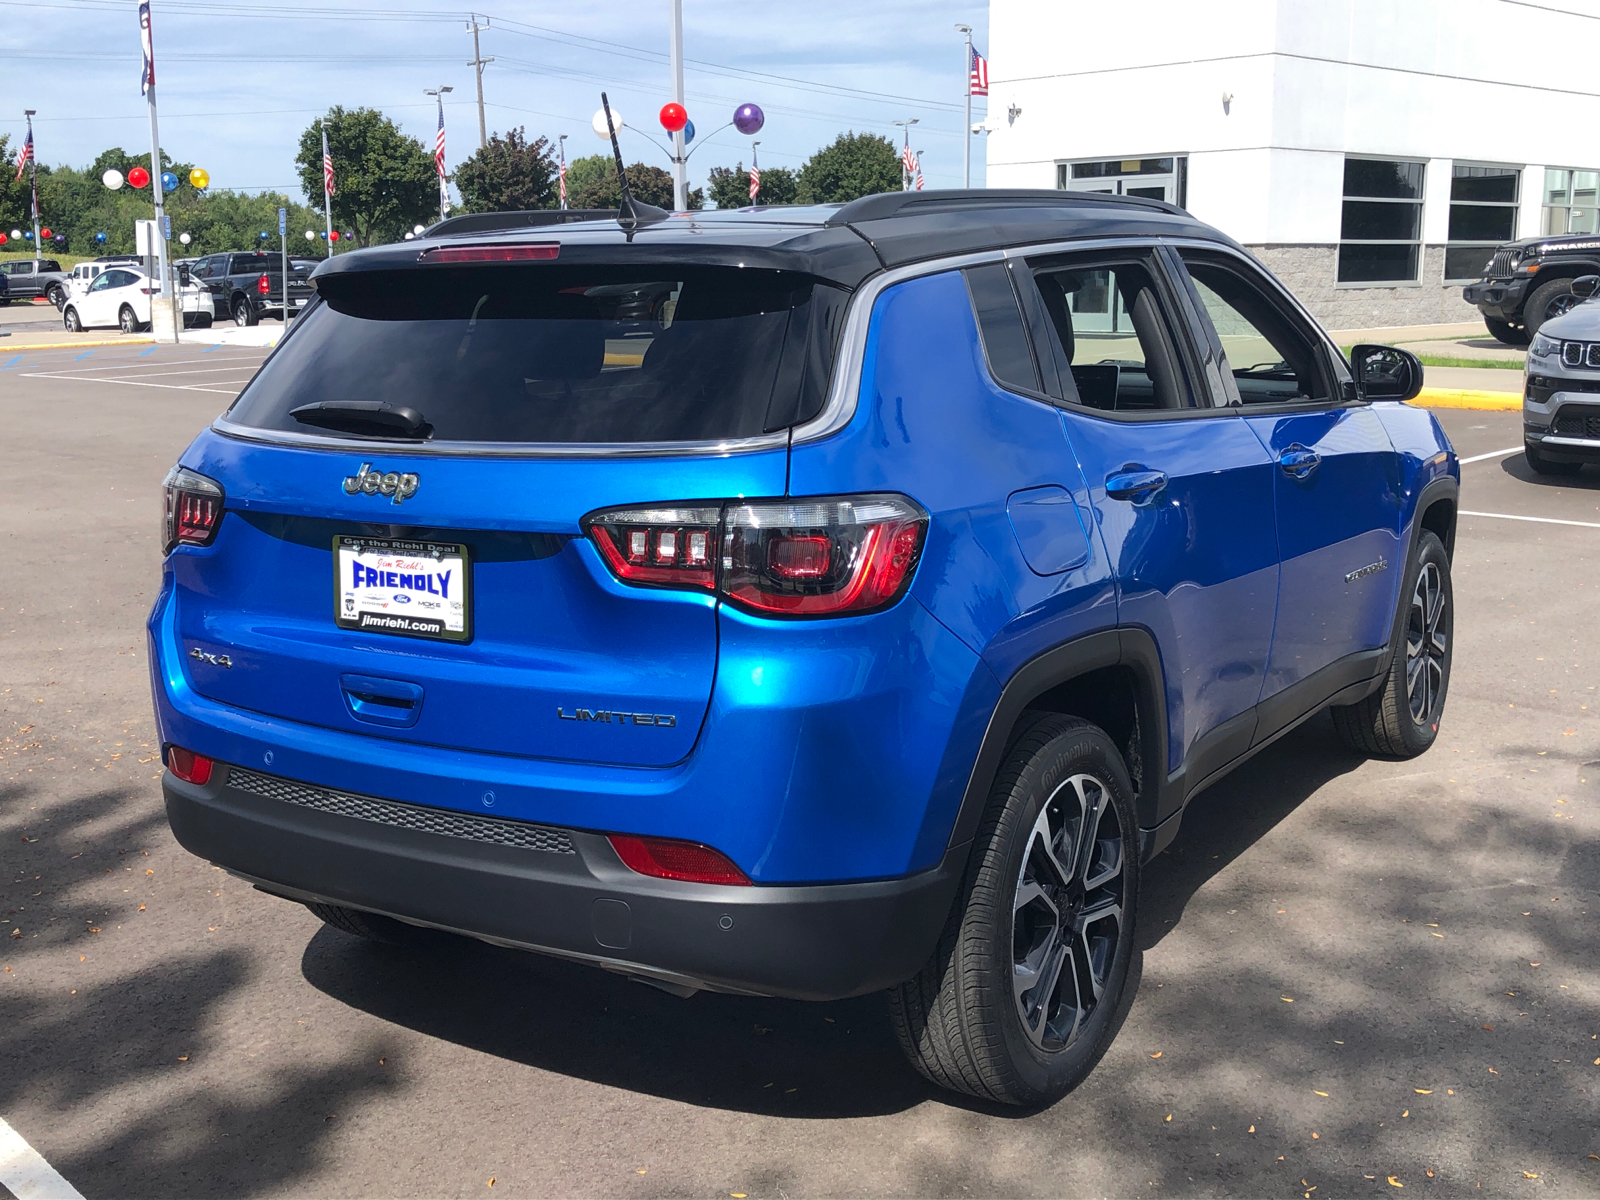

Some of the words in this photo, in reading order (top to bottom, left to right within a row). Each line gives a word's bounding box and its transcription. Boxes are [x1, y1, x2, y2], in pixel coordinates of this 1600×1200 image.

[342, 462, 420, 505] Jeep
[344, 538, 365, 546] Get
[369, 540, 389, 548] the
[392, 541, 423, 550] Riehl
[427, 544, 455, 553] Deal
[376, 558, 393, 570] Jim
[395, 559, 425, 571] Riehl's
[352, 559, 452, 600] FRIENDLY
[361, 614, 441, 633] jimriehl.com
[557, 706, 676, 727] LIMITED
